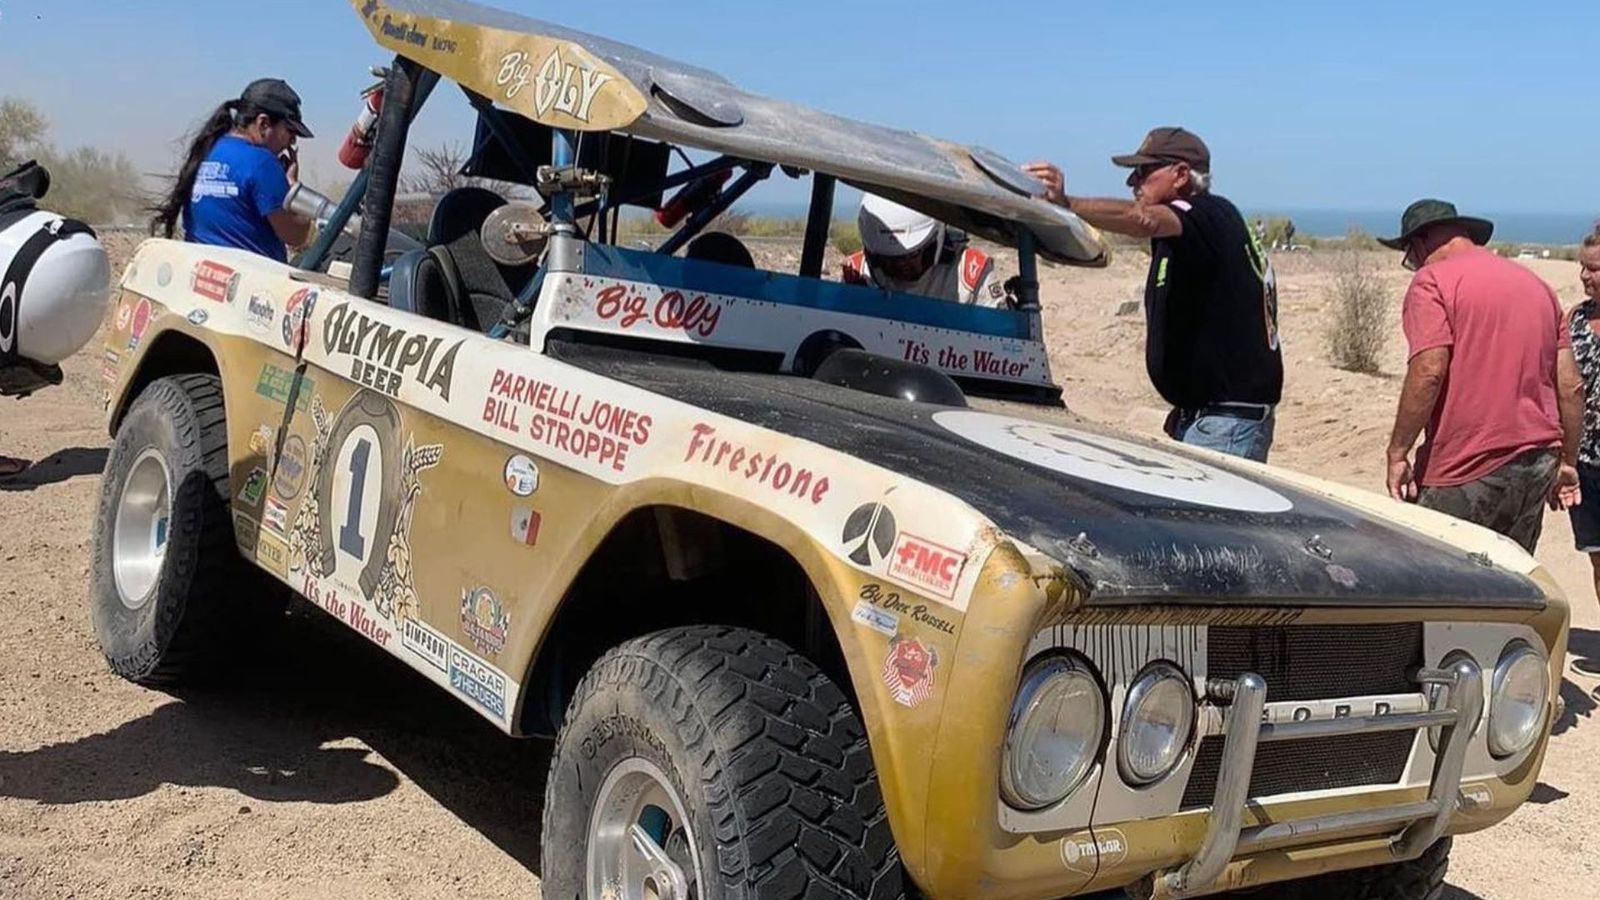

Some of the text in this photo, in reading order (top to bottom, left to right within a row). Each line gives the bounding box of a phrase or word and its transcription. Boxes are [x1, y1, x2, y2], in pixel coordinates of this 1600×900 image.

[496, 46, 612, 124] Big OLY
[323, 301, 468, 403] OLYMPIA
[938, 345, 968, 370] the
[350, 358, 403, 397] BEER
[489, 369, 653, 445] PARNELLI JONES
[482, 397, 630, 472] BILL STROPPE
[684, 422, 831, 505] Firestone
[339, 437, 372, 562] 1
[897, 540, 959, 582] FMC
[302, 576, 321, 604] It's
[325, 590, 348, 618] the
[349, 599, 393, 647] Water
[860, 583, 885, 605] By
[404, 622, 445, 659] SIMPSON
[452, 652, 503, 693] CRAGAR
[462, 675, 504, 716] HEADERS
[1262, 702, 1391, 722] ORD
